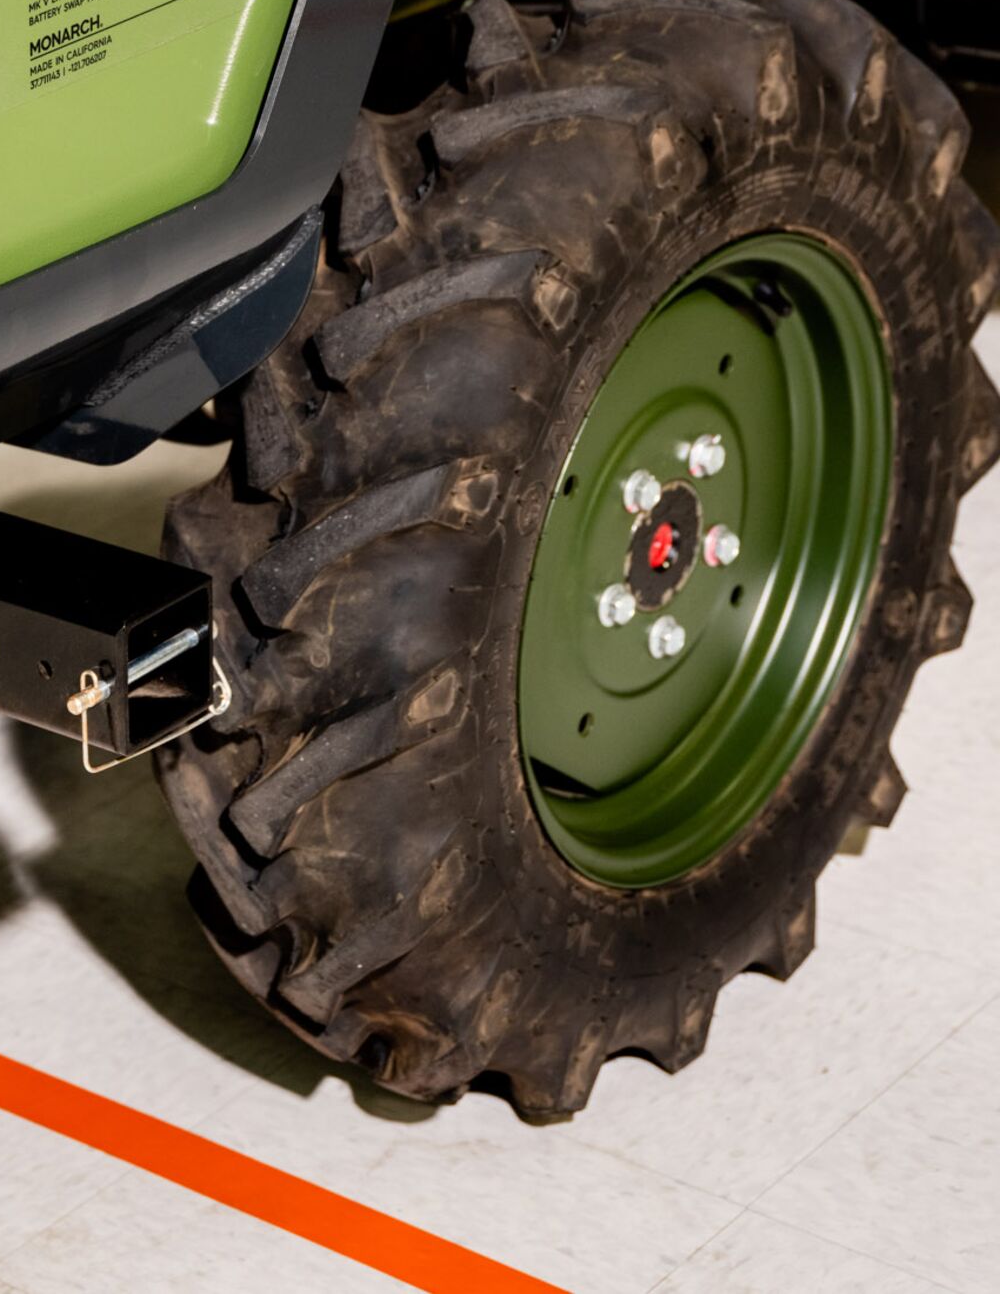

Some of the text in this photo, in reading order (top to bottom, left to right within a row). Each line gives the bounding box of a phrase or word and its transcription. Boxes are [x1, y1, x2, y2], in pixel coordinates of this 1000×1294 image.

[29, 6, 61, 26] BATTERY
[30, 35, 113, 76] MADE IN CALIFORNIA
